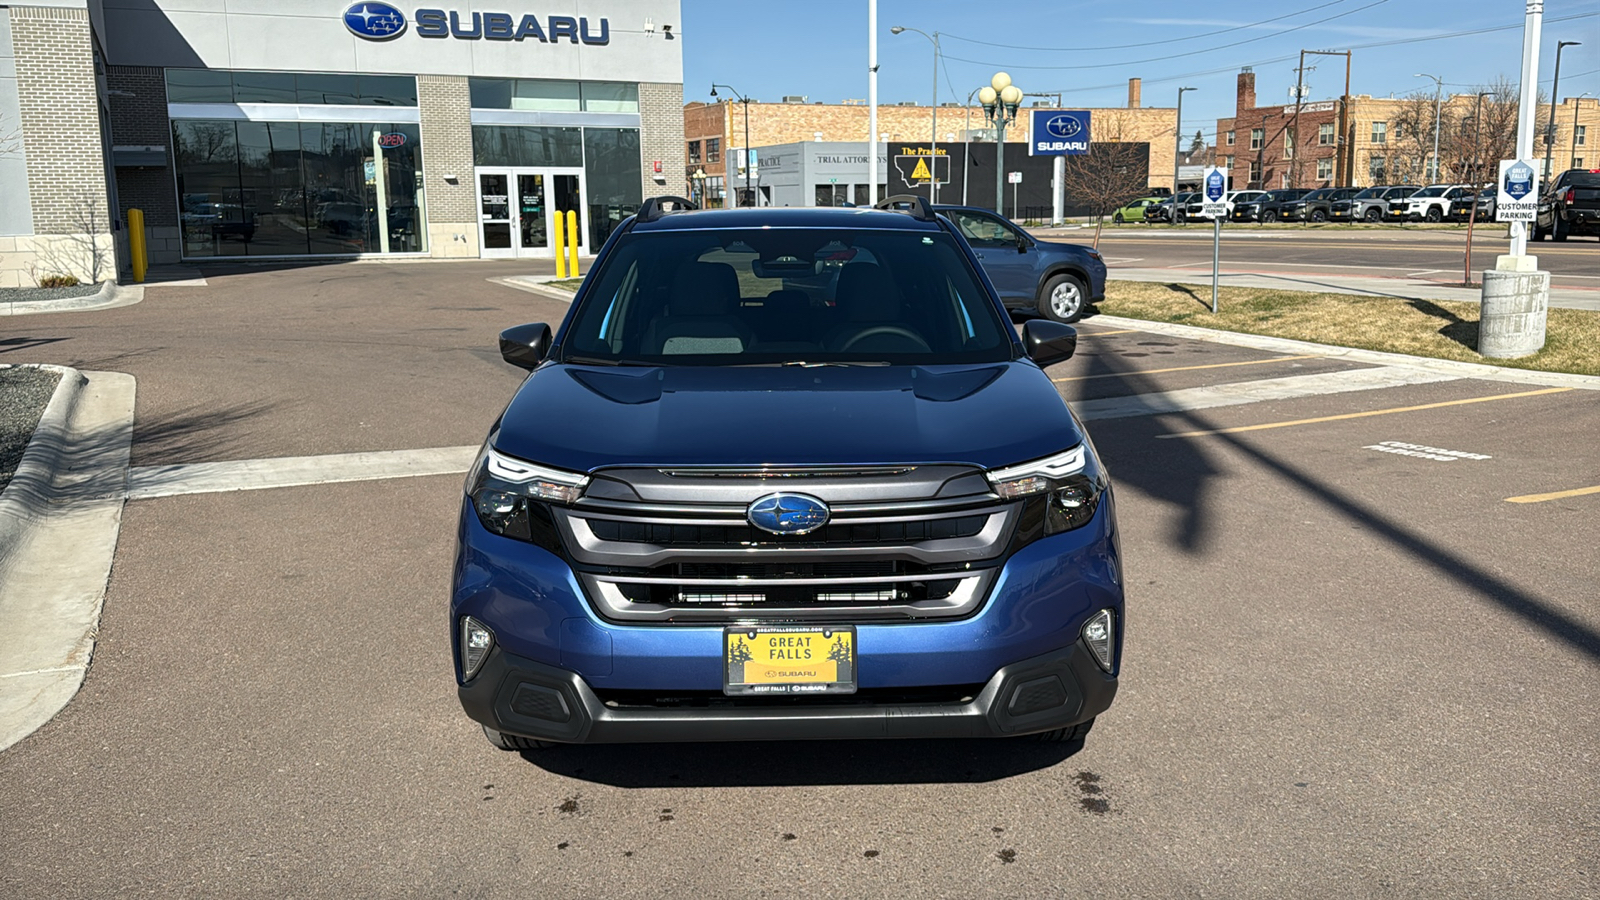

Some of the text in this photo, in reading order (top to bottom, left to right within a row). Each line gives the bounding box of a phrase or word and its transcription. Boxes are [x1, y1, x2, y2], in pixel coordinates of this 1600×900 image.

[415, 9, 610, 46] SUBARU
[378, 135, 404, 145] OPEN
[901, 147, 916, 155] The
[1037, 142, 1087, 151] SUBARU
[843, 156, 887, 164] ATTORYS
[769, 637, 811, 647] GREAT
[769, 649, 812, 659] FALLS
